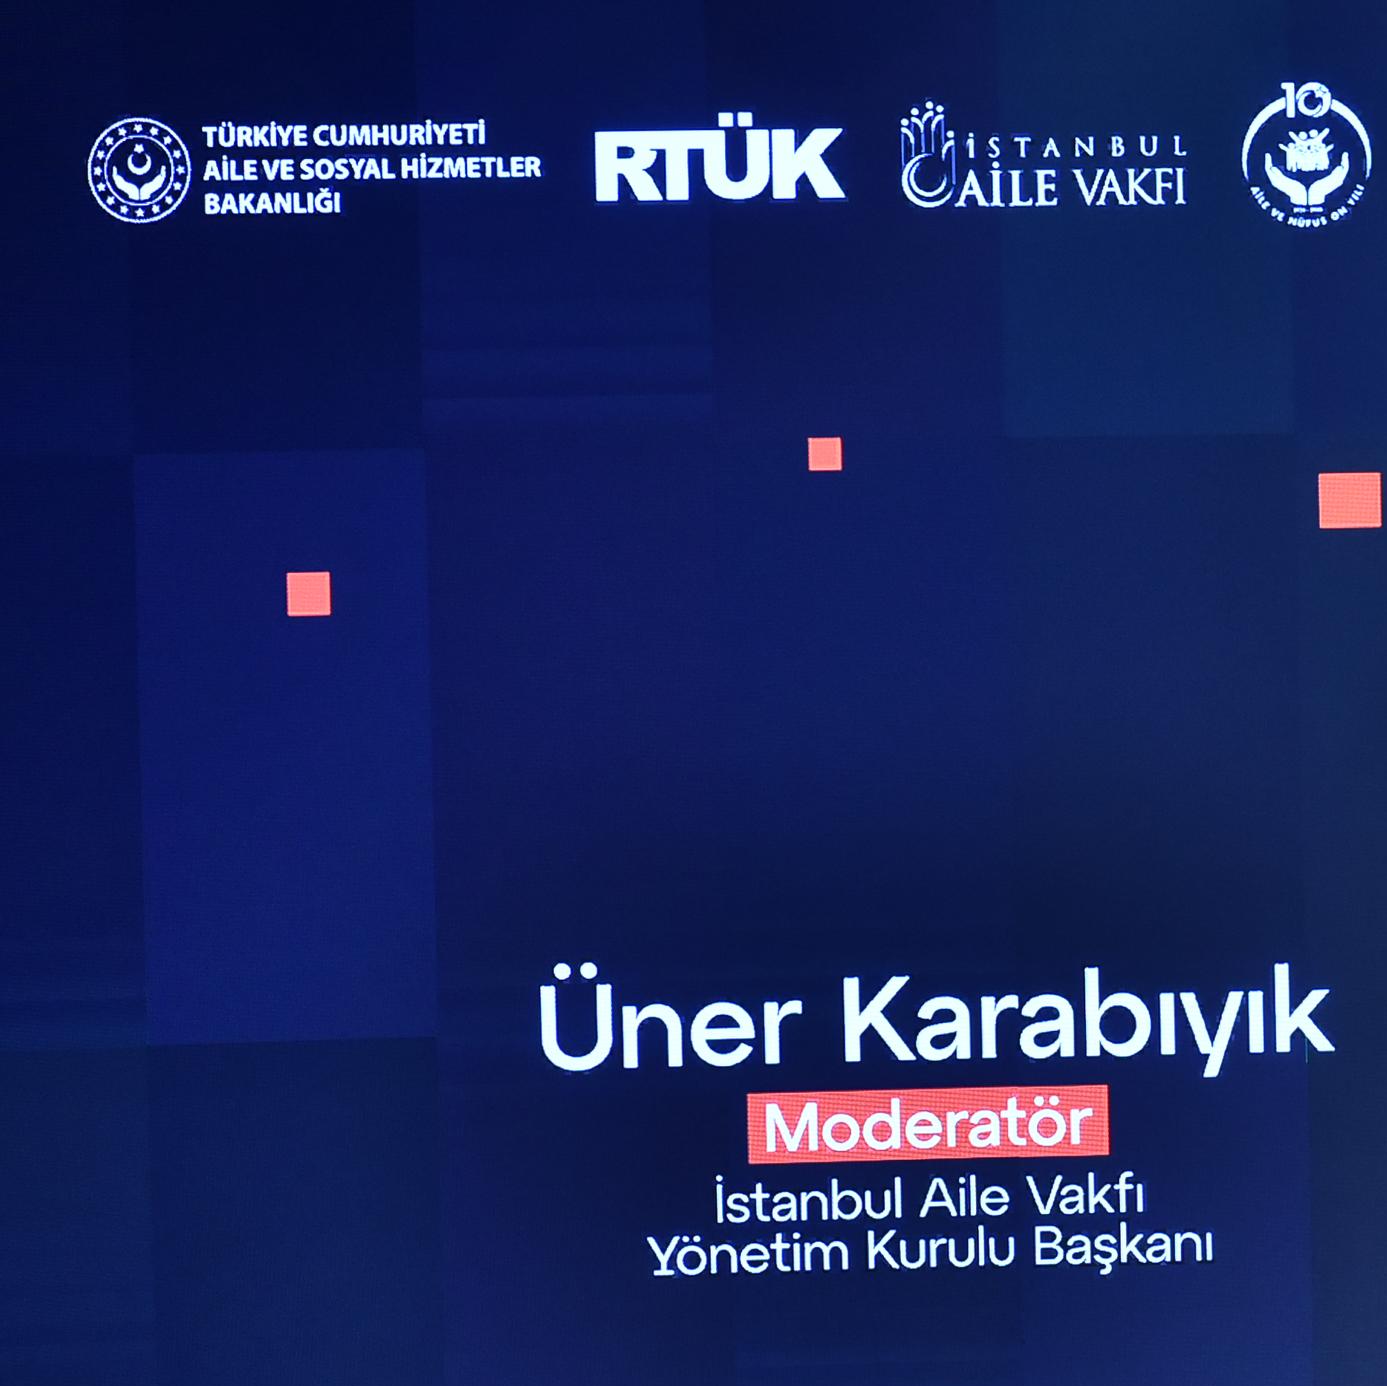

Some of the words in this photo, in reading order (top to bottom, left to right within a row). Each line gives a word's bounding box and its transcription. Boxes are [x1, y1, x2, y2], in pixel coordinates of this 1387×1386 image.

[202, 121, 307, 147] TÜRKİYE
[313, 119, 485, 146] CUMHURİYETİ
[967, 133, 1186, 158] İSTANBUL
[203, 155, 258, 180] AİLE
[262, 159, 294, 180] VE
[300, 158, 396, 180] SOSYAL
[401, 153, 541, 178] HİZMETLER
[595, 112, 845, 201] RTÜK
[205, 188, 340, 214] BAKANLIĞI
[954, 161, 1057, 207] AİLE
[1072, 168, 1186, 205] VAKFI
[1250, 186, 1271, 210] AİLE
[1271, 208, 1285, 222] VE
[1287, 216, 1327, 228] NÜFUS
[1330, 206, 1348, 221] ON
[540, 963, 802, 1071] Üner
[844, 963, 1335, 1077] Karabıyık
[766, 1096, 1093, 1152] Moderatör
[716, 1175, 901, 1223] İstanbul
[920, 1175, 1009, 1217] Aile
[1026, 1171, 1143, 1214] Vakfı
[647, 1233, 848, 1275] Yönetim
[868, 1225, 1014, 1269] Kurulu
[1035, 1222, 1212, 1275] Başkanı
